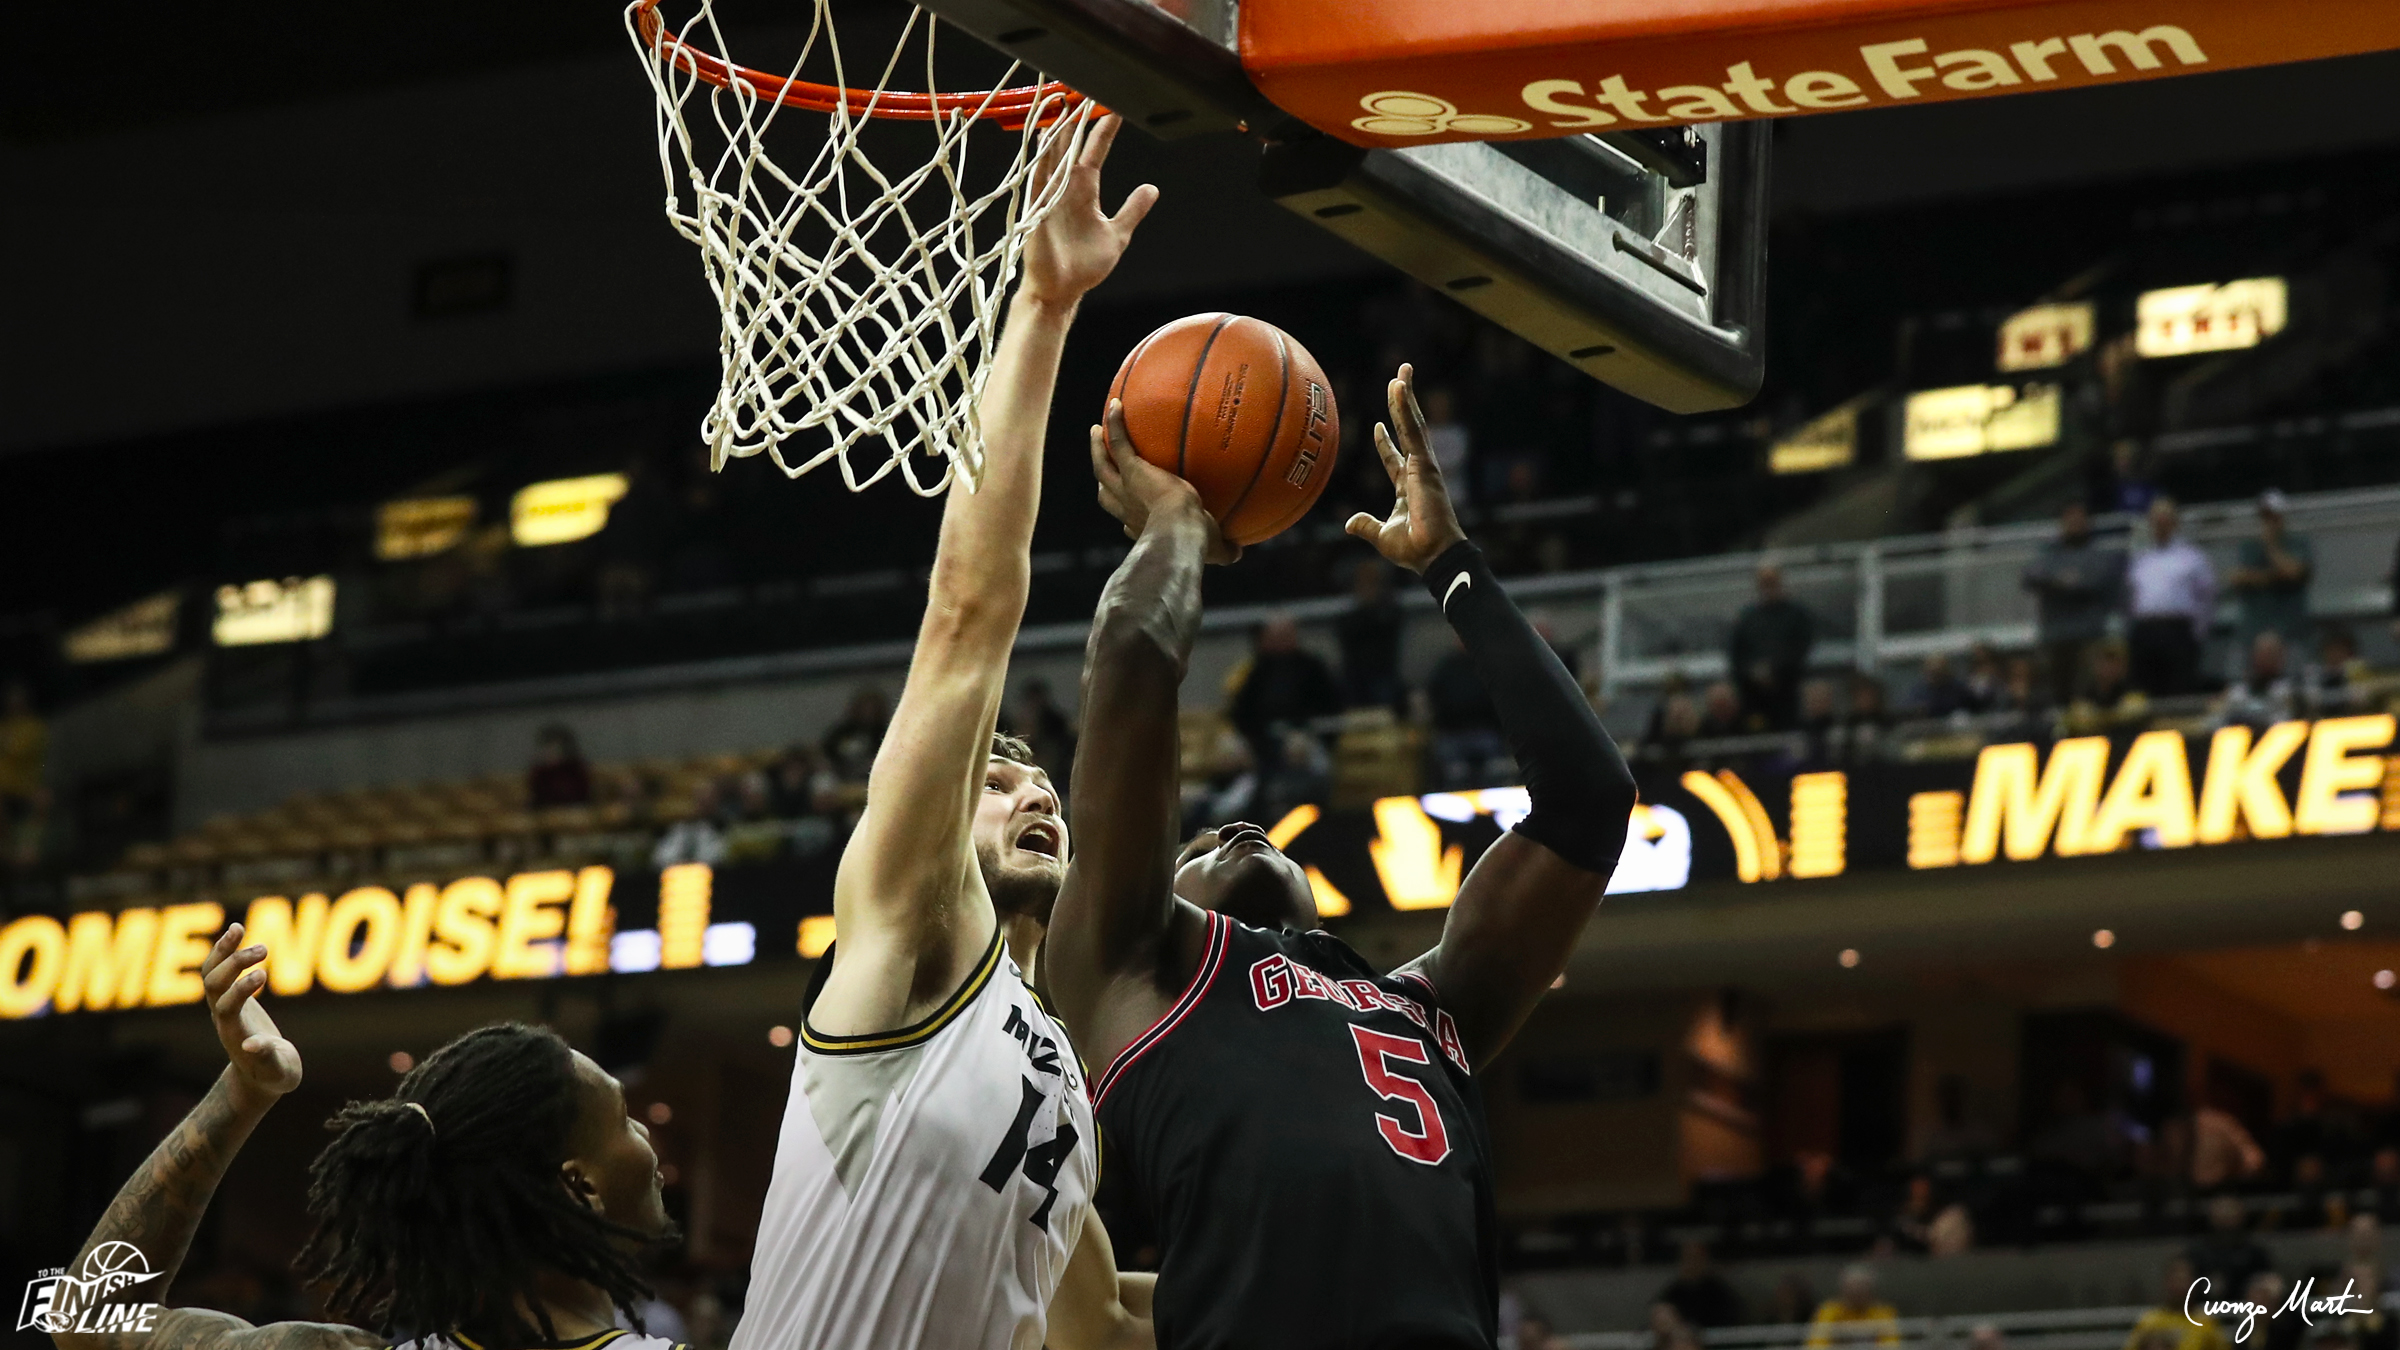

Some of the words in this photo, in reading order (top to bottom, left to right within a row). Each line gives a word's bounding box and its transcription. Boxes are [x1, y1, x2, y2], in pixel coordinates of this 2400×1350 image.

[1288, 382, 1328, 490] ELITE
[1960, 713, 2396, 866] MAKE
[242, 865, 615, 996] NOISE!
[978, 1072, 1079, 1236] 14
[1348, 1022, 1450, 1167] 5
